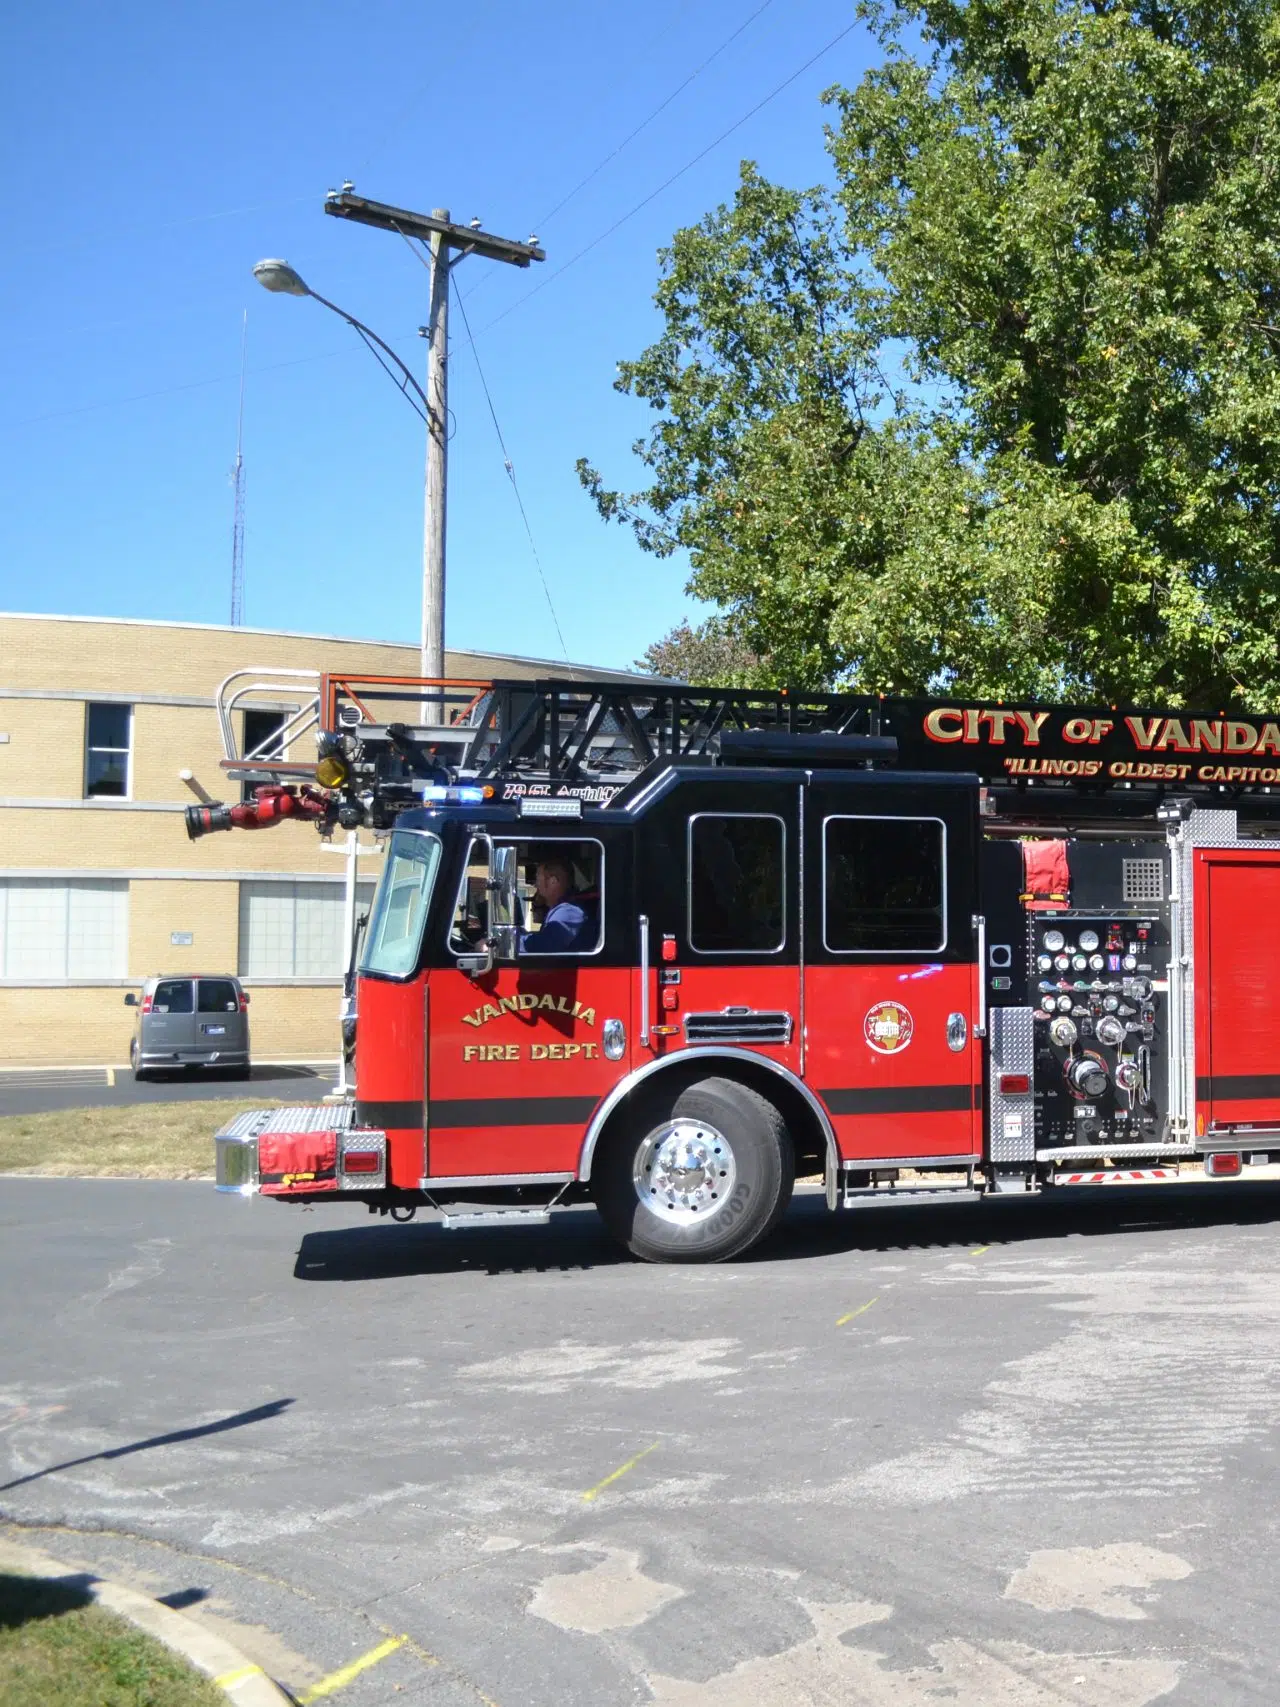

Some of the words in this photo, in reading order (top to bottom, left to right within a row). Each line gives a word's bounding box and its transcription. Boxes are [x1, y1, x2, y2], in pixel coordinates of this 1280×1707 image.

[923, 707, 1050, 745] CITY
[1062, 718, 1114, 745] OF
[1108, 761, 1192, 779] OLDEST
[461, 994, 597, 1027] VANDALIA
[464, 1044, 520, 1061] FIRE
[531, 1043, 600, 1060] DEPT.
